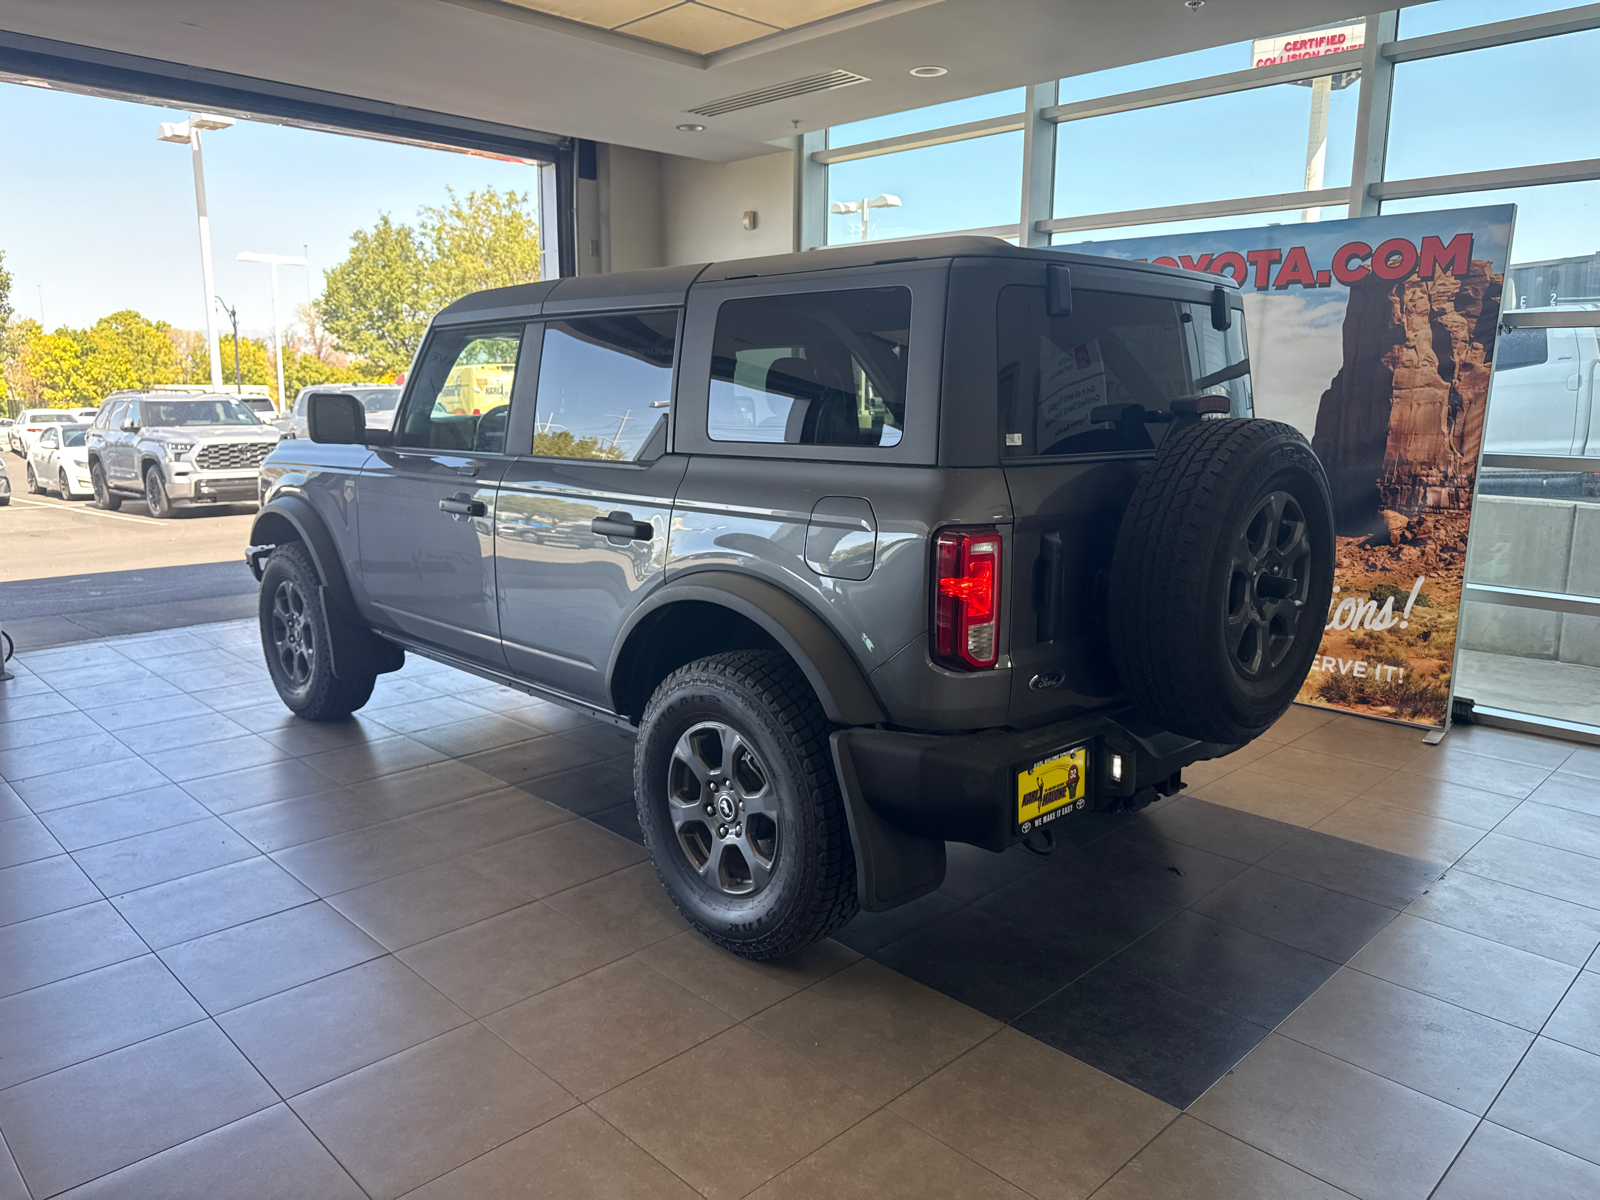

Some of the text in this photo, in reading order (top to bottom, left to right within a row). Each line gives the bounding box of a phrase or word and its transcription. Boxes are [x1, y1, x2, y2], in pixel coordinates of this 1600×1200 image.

[1283, 33, 1346, 52] CERTIFIED
[1131, 233, 1475, 292] YOTA.COM
[1375, 664, 1405, 684] IT!
[1069, 769, 1077, 779] 32
[1034, 804, 1073, 827] WE MAKE IT EASY
